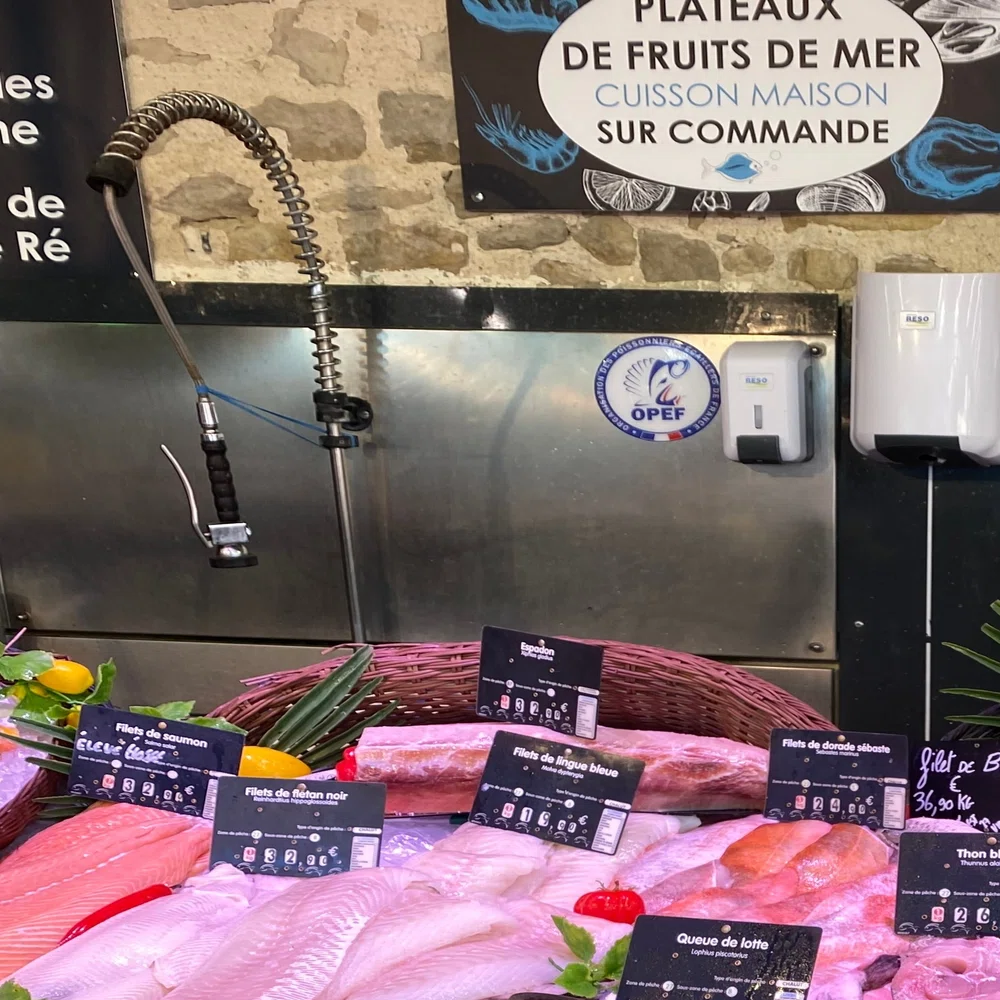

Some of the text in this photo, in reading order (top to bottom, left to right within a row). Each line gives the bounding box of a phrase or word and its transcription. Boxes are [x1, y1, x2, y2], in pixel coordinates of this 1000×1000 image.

[634, 0, 841, 22] PLATEAUX
[562, 38, 920, 70] DE FRUITS DE MER
[0, 74, 54, 99] es
[595, 82, 888, 108] CUISSON MAISON
[597, 119, 889, 145] SUR COMMANDE
[8, 187, 65, 219] de
[17, 228, 71, 262] Ré
[599, 360, 613, 375] DES
[712, 387, 719, 398] DE
[631, 407, 685, 421] OPEF
[695, 402, 719, 430] FRANCE
[521, 641, 554, 656] Espadon
[116, 723, 208, 748] Filets de saumon
[782, 739, 890, 754] Filets de dorade sébaste
[513, 747, 619, 777] Filets de lingue bleue
[957, 761, 975, 773] DE
[949, 775, 961, 792] €
[245, 787, 273, 796] Filets
[275, 788, 290, 797] de
[326, 791, 348, 800] noir
[913, 790, 954, 817] 36,90
[956, 849, 987, 858] Thon
[677, 933, 769, 950] Queue de lotte
[691, 949, 748, 959] Lophius piscatorius
